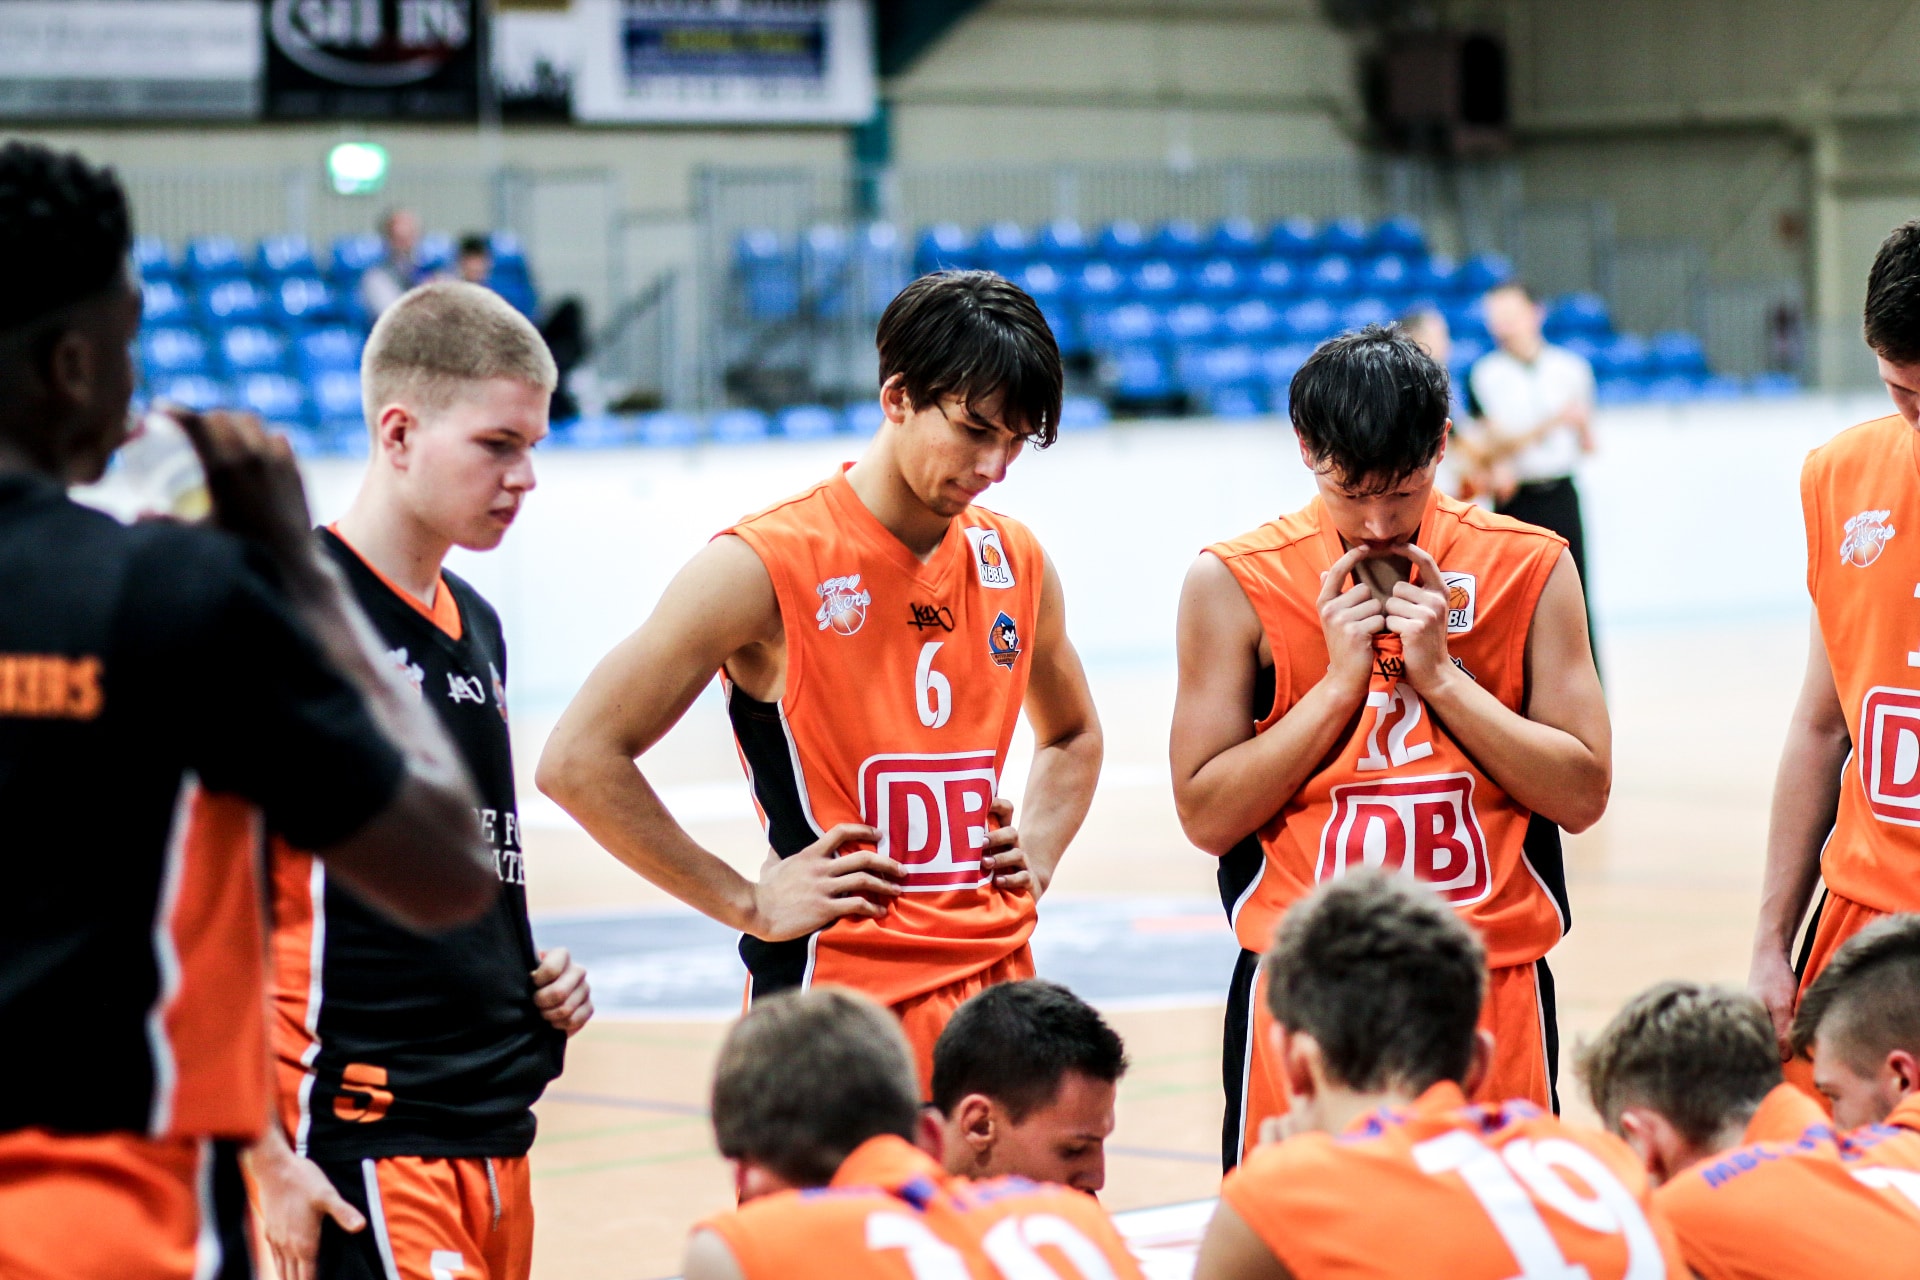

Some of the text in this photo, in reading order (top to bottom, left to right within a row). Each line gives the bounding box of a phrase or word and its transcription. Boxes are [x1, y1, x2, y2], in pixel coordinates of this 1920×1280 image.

[980, 564, 1008, 583] NBBL
[1447, 609, 1468, 627] BL
[915, 641, 952, 729] 6
[1356, 683, 1434, 771] 12
[888, 778, 991, 865] DB
[1345, 800, 1470, 883] DB
[332, 1062, 394, 1124] 5
[1411, 1129, 1667, 1280] 19
